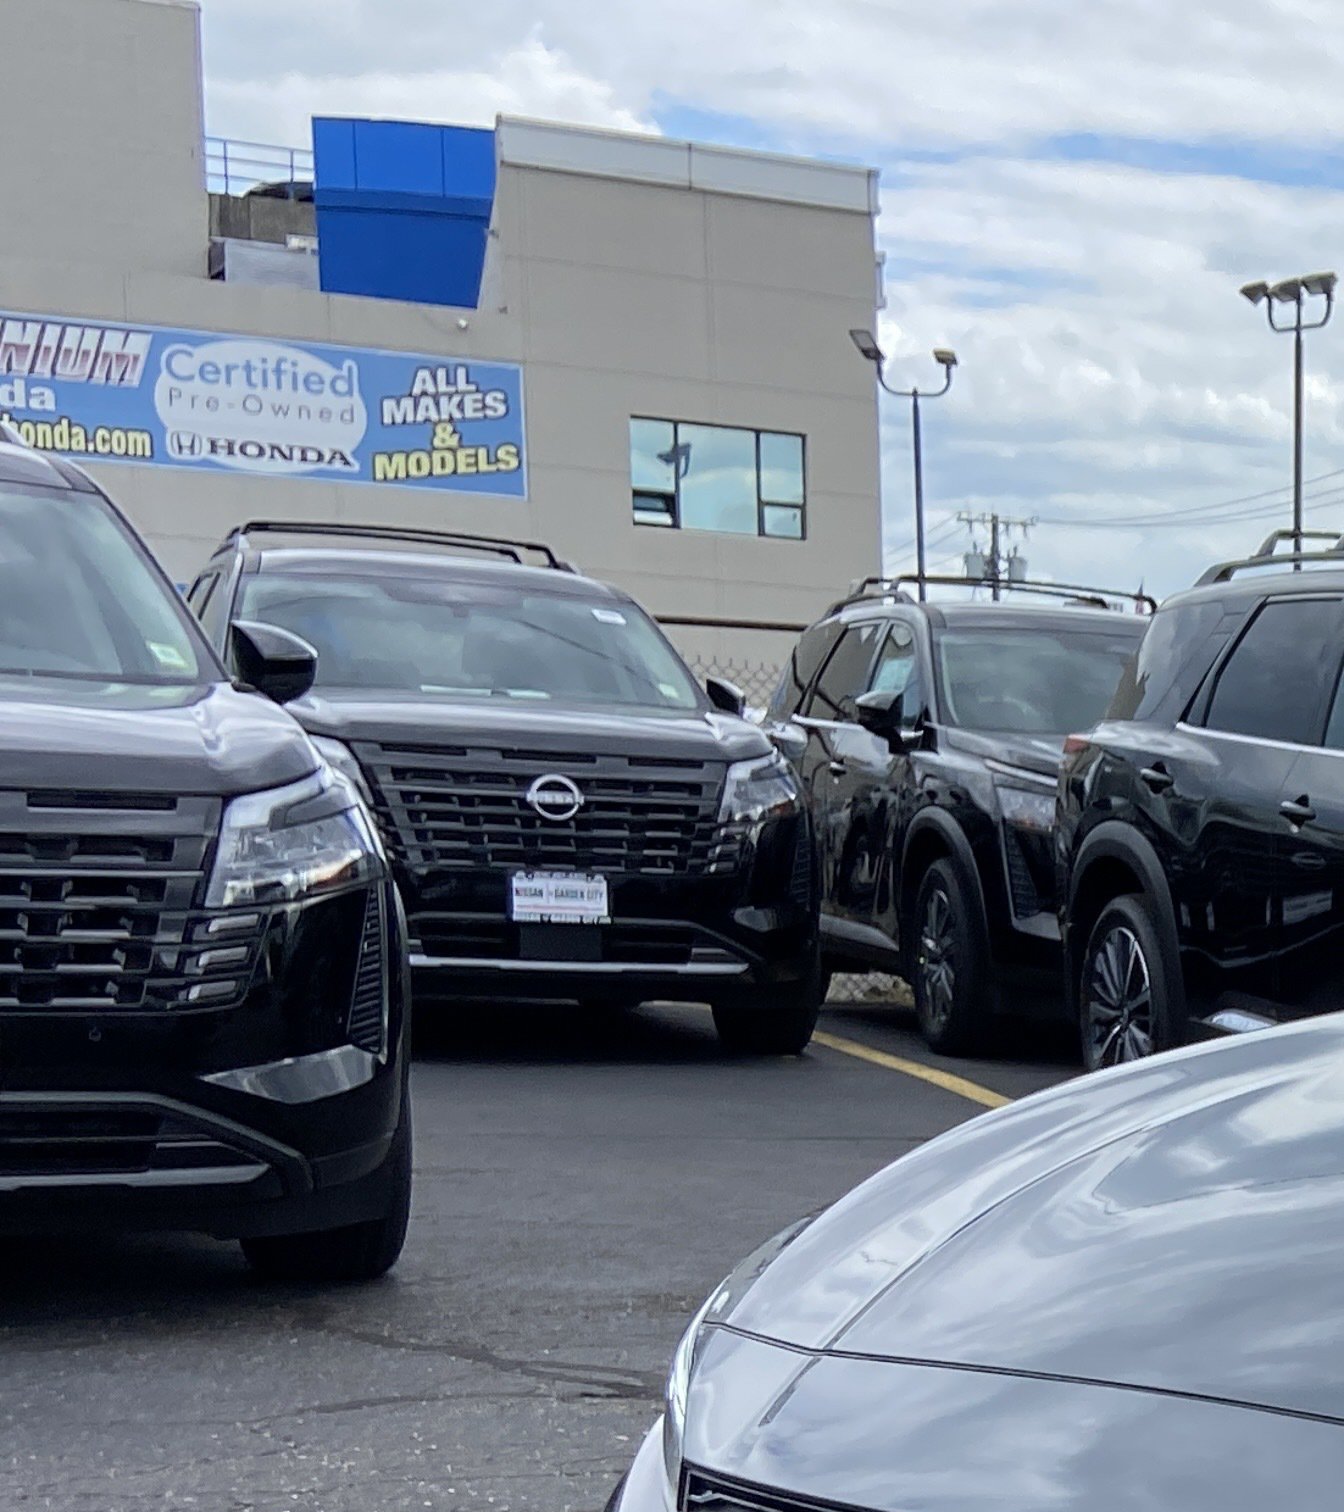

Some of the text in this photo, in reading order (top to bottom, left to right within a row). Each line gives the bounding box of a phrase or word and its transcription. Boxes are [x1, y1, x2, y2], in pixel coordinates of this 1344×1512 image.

[0, 318, 153, 388] NIUM
[165, 349, 355, 398] Certified
[412, 367, 478, 396] ALL
[167, 387, 356, 425] Pre-Owned
[382, 392, 508, 426] MAKES
[207, 437, 354, 467] HONDA
[433, 423, 461, 450] &
[374, 445, 519, 482] MODELS
